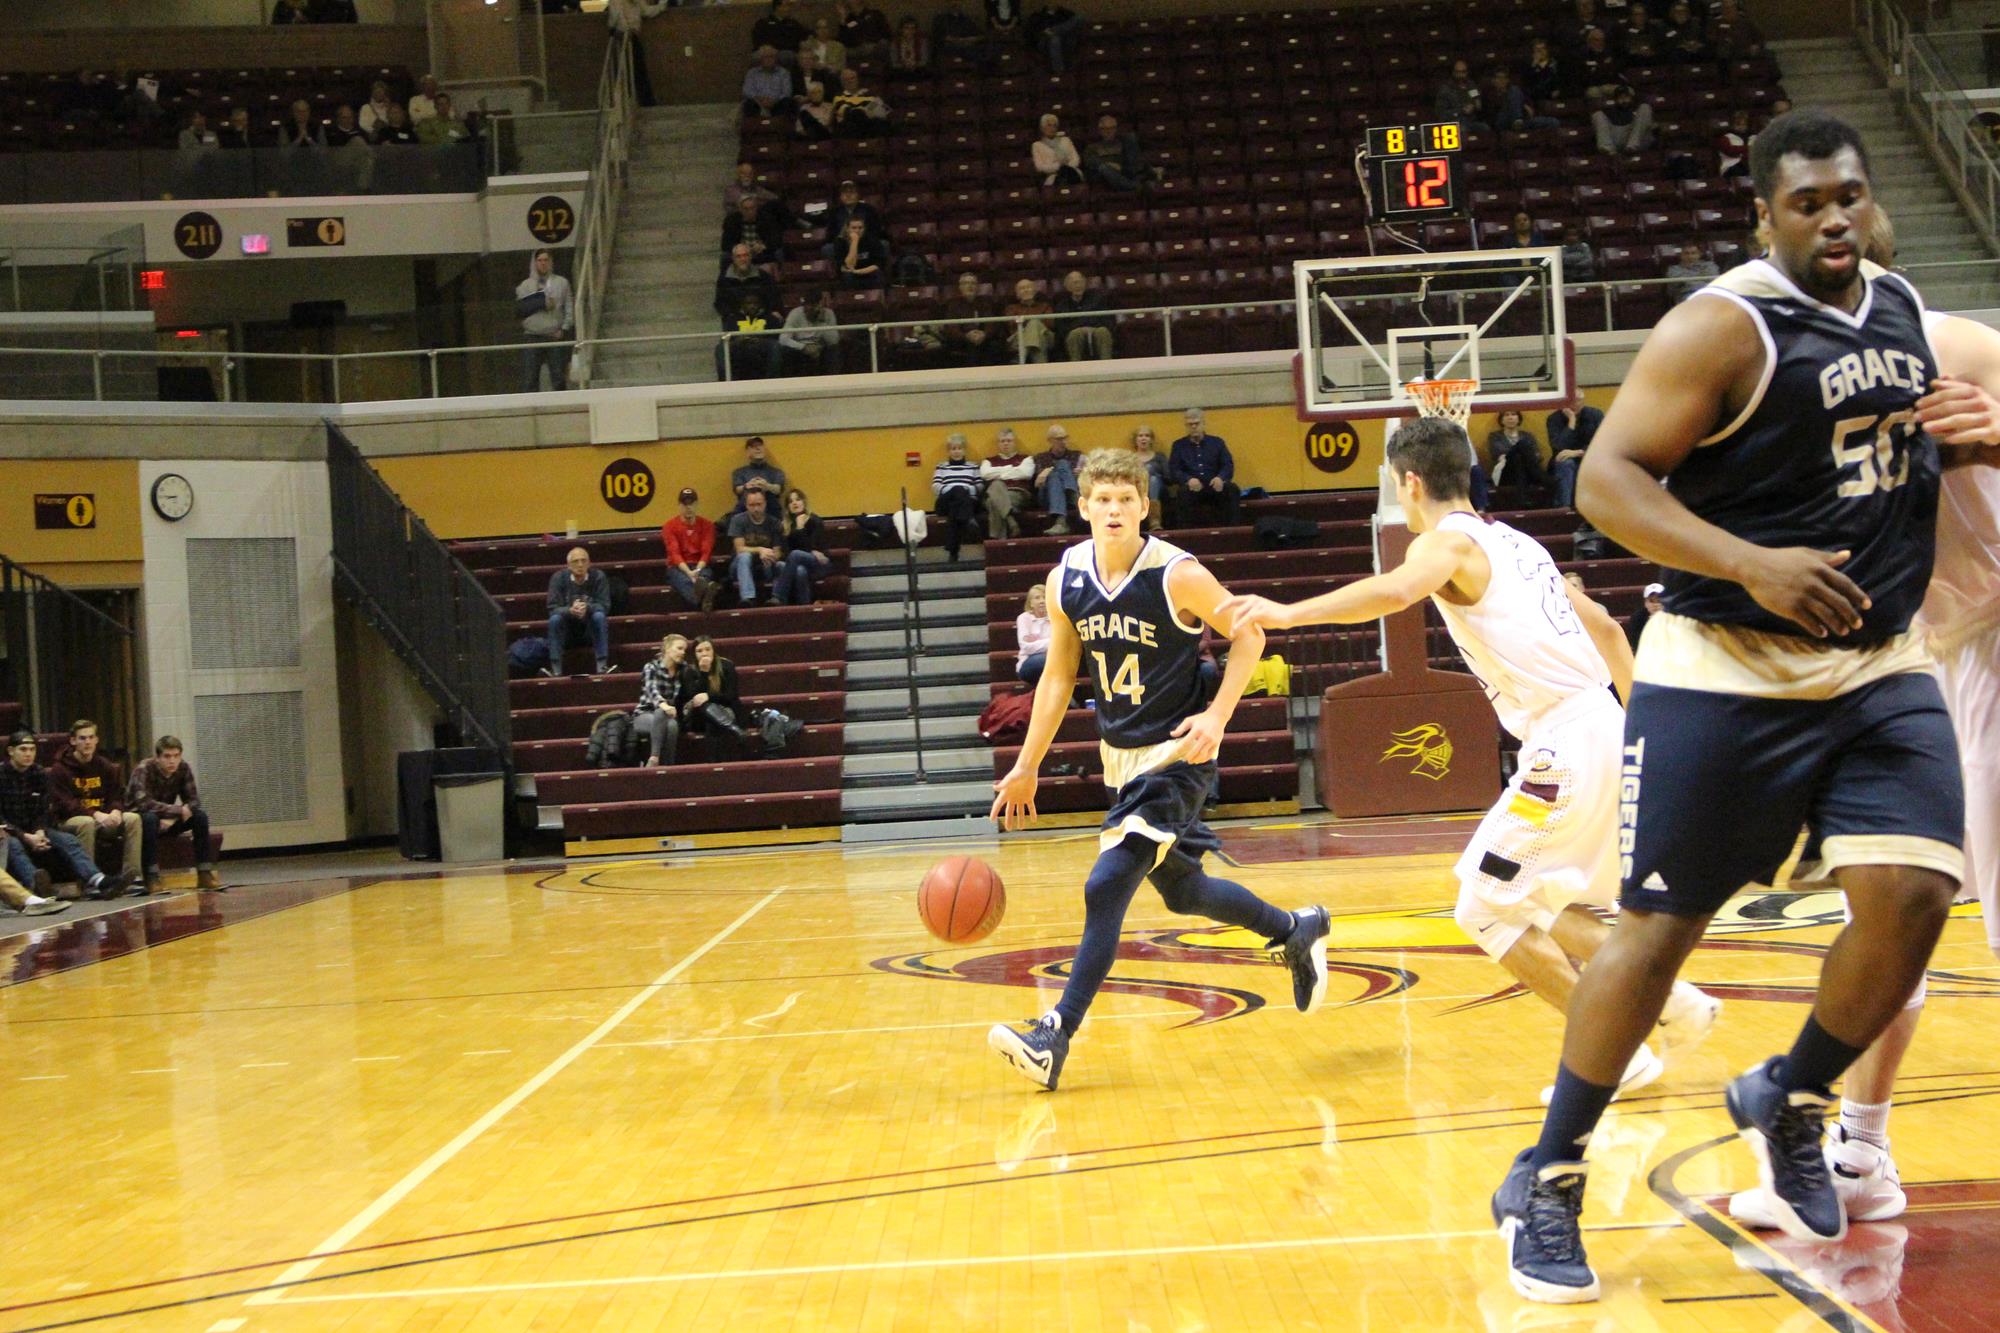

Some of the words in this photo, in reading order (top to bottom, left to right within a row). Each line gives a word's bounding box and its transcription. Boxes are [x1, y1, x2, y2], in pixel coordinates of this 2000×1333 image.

[1386, 129, 1405, 154] 8
[1432, 125, 1459, 149] 18
[1404, 159, 1447, 208] 12
[182, 224, 216, 247] 211
[531, 208, 571, 231] 212
[1819, 348, 1926, 410] GRACE
[1310, 432, 1354, 458] 109
[605, 473, 650, 498] 108
[1075, 613, 1159, 648] GRACE
[1090, 650, 1146, 705] 14
[1619, 736, 1646, 880] TIGERS
